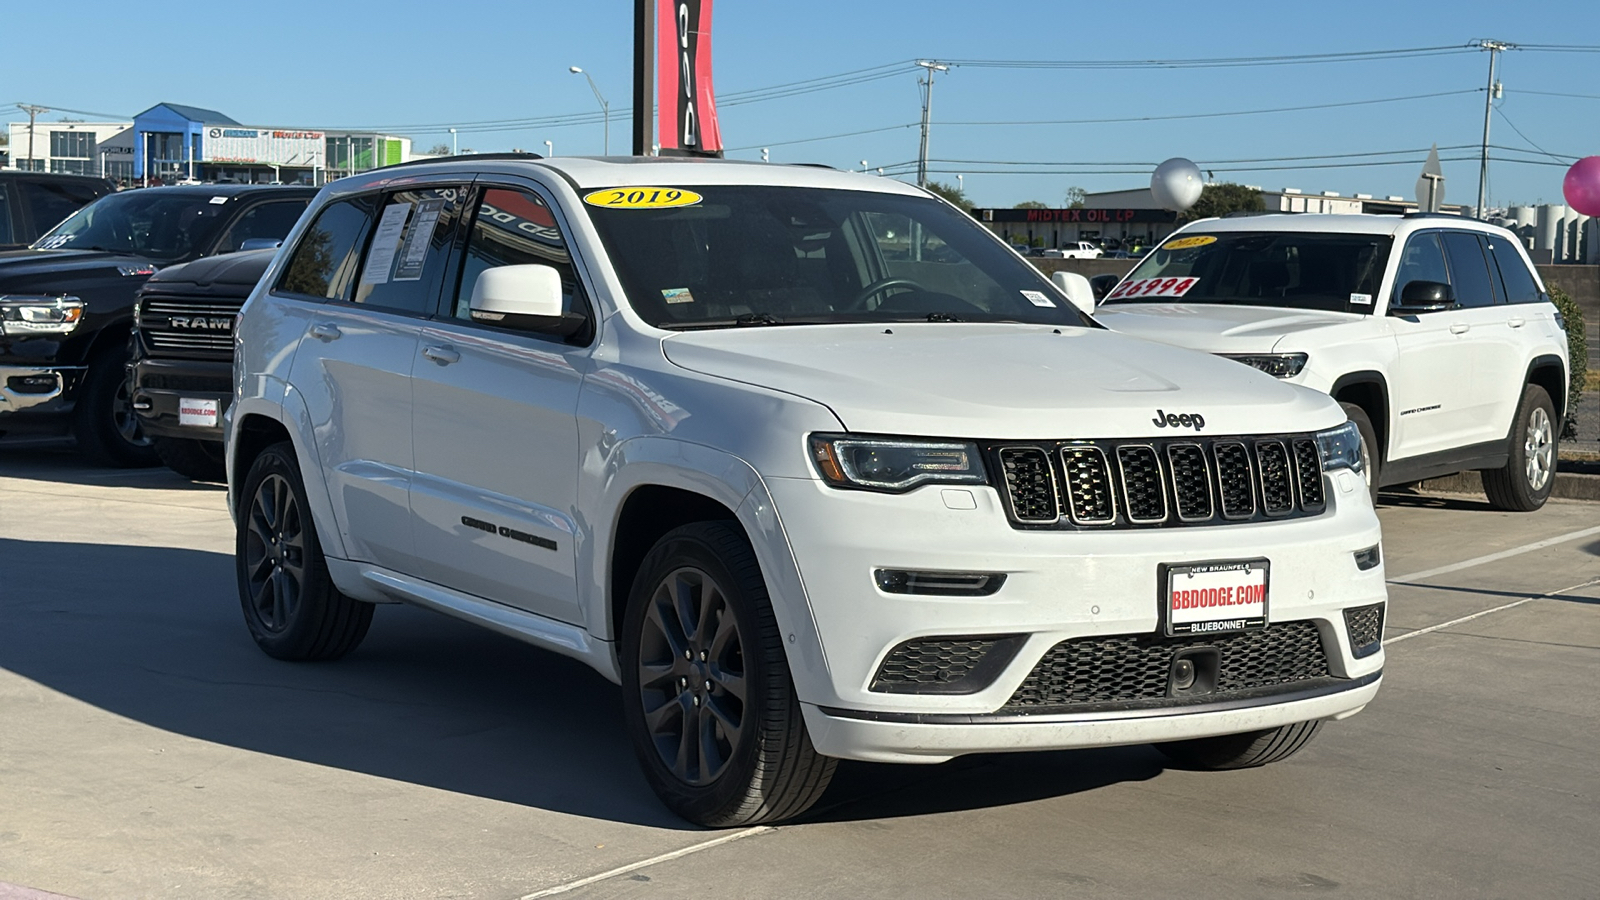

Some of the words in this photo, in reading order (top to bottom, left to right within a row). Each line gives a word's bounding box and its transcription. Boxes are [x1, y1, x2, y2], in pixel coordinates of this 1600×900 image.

[607, 190, 682, 205] 2019
[1027, 209, 1080, 222] MIDTEX
[1087, 209, 1110, 222] OIL
[1116, 209, 1135, 221] LP
[1111, 277, 1192, 299] 26994
[171, 316, 231, 330] RAM
[1152, 409, 1206, 431] Jeep
[1172, 584, 1266, 610] BBDODGE.COM
[1191, 619, 1247, 633] BLUEBONNET
